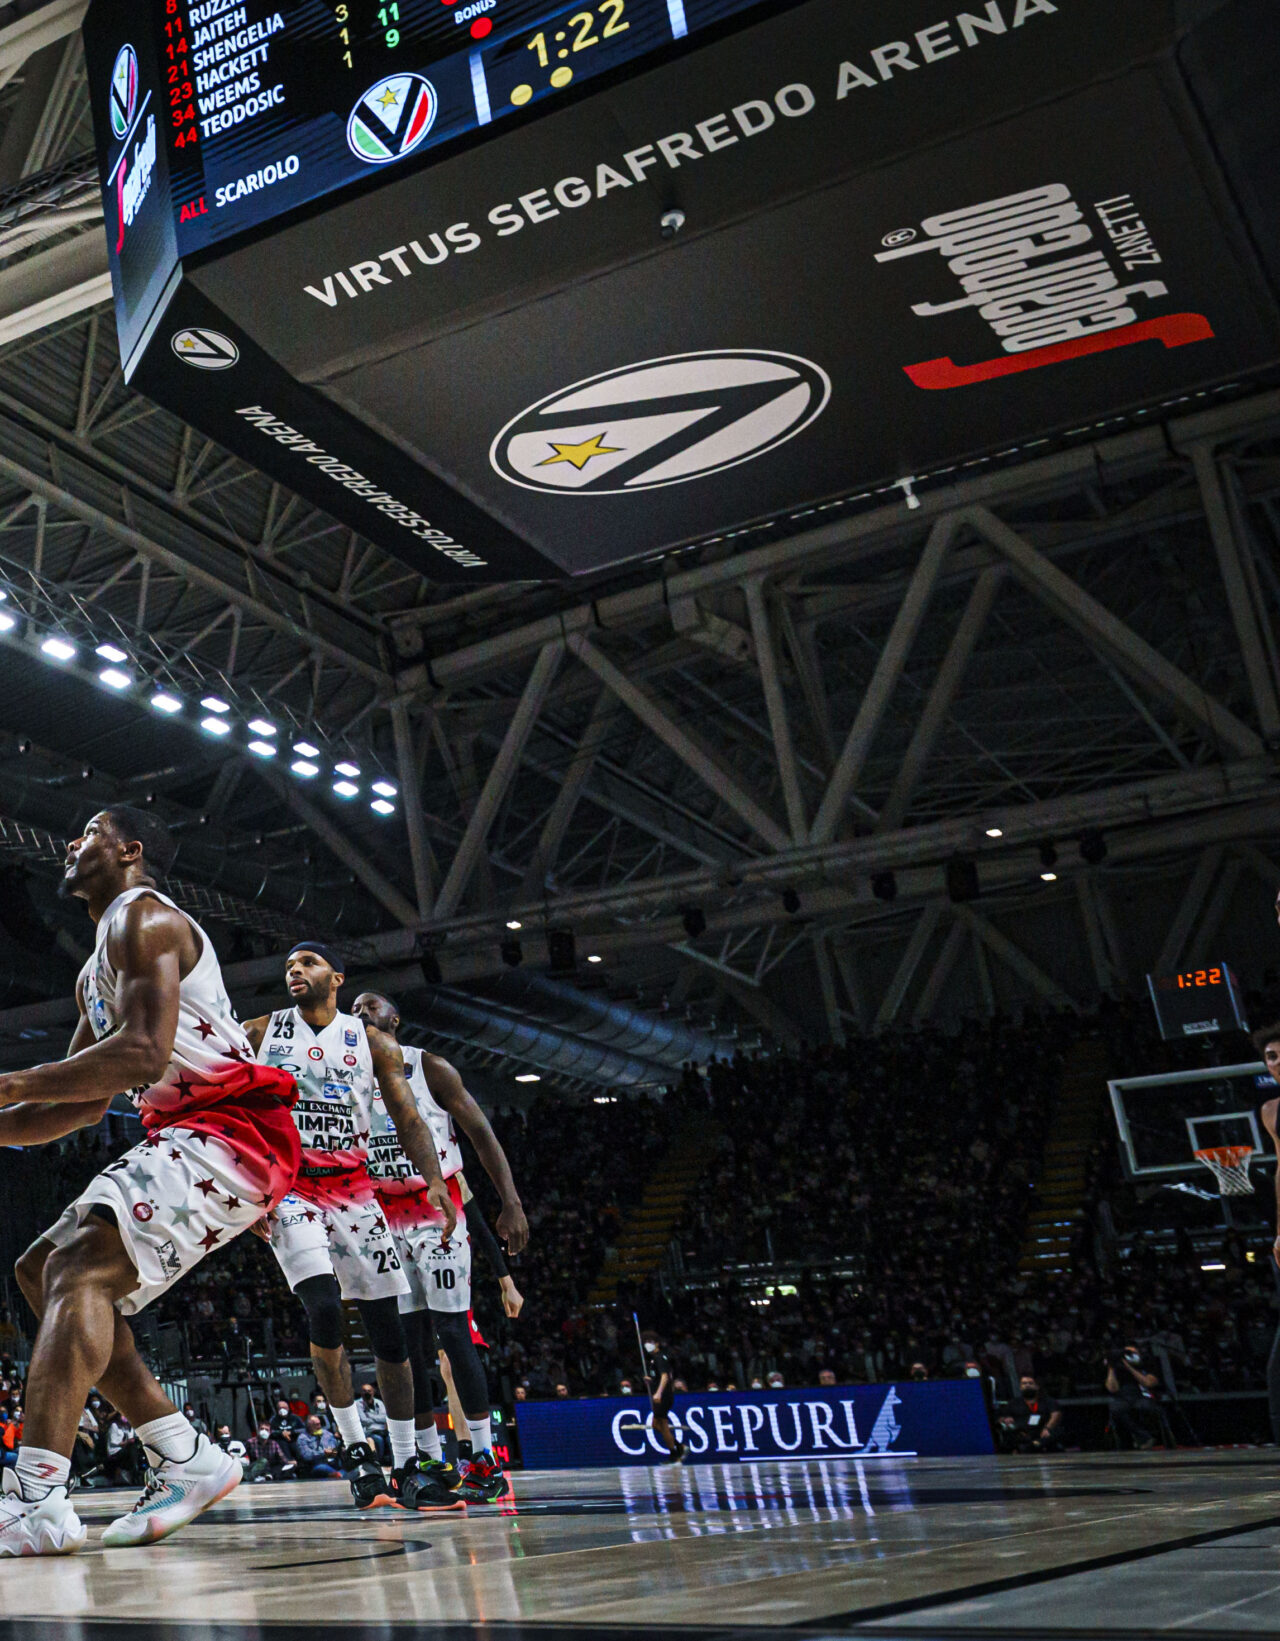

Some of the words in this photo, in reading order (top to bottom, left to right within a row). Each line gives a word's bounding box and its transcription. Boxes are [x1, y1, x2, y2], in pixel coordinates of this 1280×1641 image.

[164, 17, 183, 38] 11
[335, 4, 349, 23] 3
[377, 3, 400, 27] 11
[454, 0, 496, 24] BONUS
[166, 37, 188, 60] 14
[191, 7, 247, 50] JAITEH
[167, 60, 188, 84] 21
[193, 13, 286, 72] SHENGELIA
[339, 27, 350, 45] 1
[385, 29, 400, 48] 9
[527, 0, 630, 67] 1:22
[169, 82, 193, 106] 23
[196, 43, 269, 94] HACKETT
[342, 51, 353, 68] 1
[172, 103, 196, 127] 34
[197, 72, 261, 115] WEEMS
[174, 126, 198, 148] 44
[200, 84, 286, 138] TEODOSIC
[303, 220, 483, 308] VIRTUS
[487, 83, 816, 238] SEGAFREDO
[835, 0, 1058, 101] ARENA
[179, 197, 209, 223] ALL
[215, 155, 300, 208] SCARIOLO
[1094, 194, 1163, 272] ZANETTI
[874, 183, 1215, 390] Segafredo
[235, 405, 327, 453] ARENA
[305, 455, 432, 528] SEGAFREDO
[411, 528, 489, 568] VIRTUS
[1177, 968, 1221, 989] 1:22
[268, 1044, 294, 1056] EA7
[272, 1021, 295, 1040] 23
[324, 1085, 347, 1098] SAP
[372, 1246, 402, 1275] 23
[431, 1268, 456, 1290] 10
[611, 1400, 865, 1456] COSEPURI
